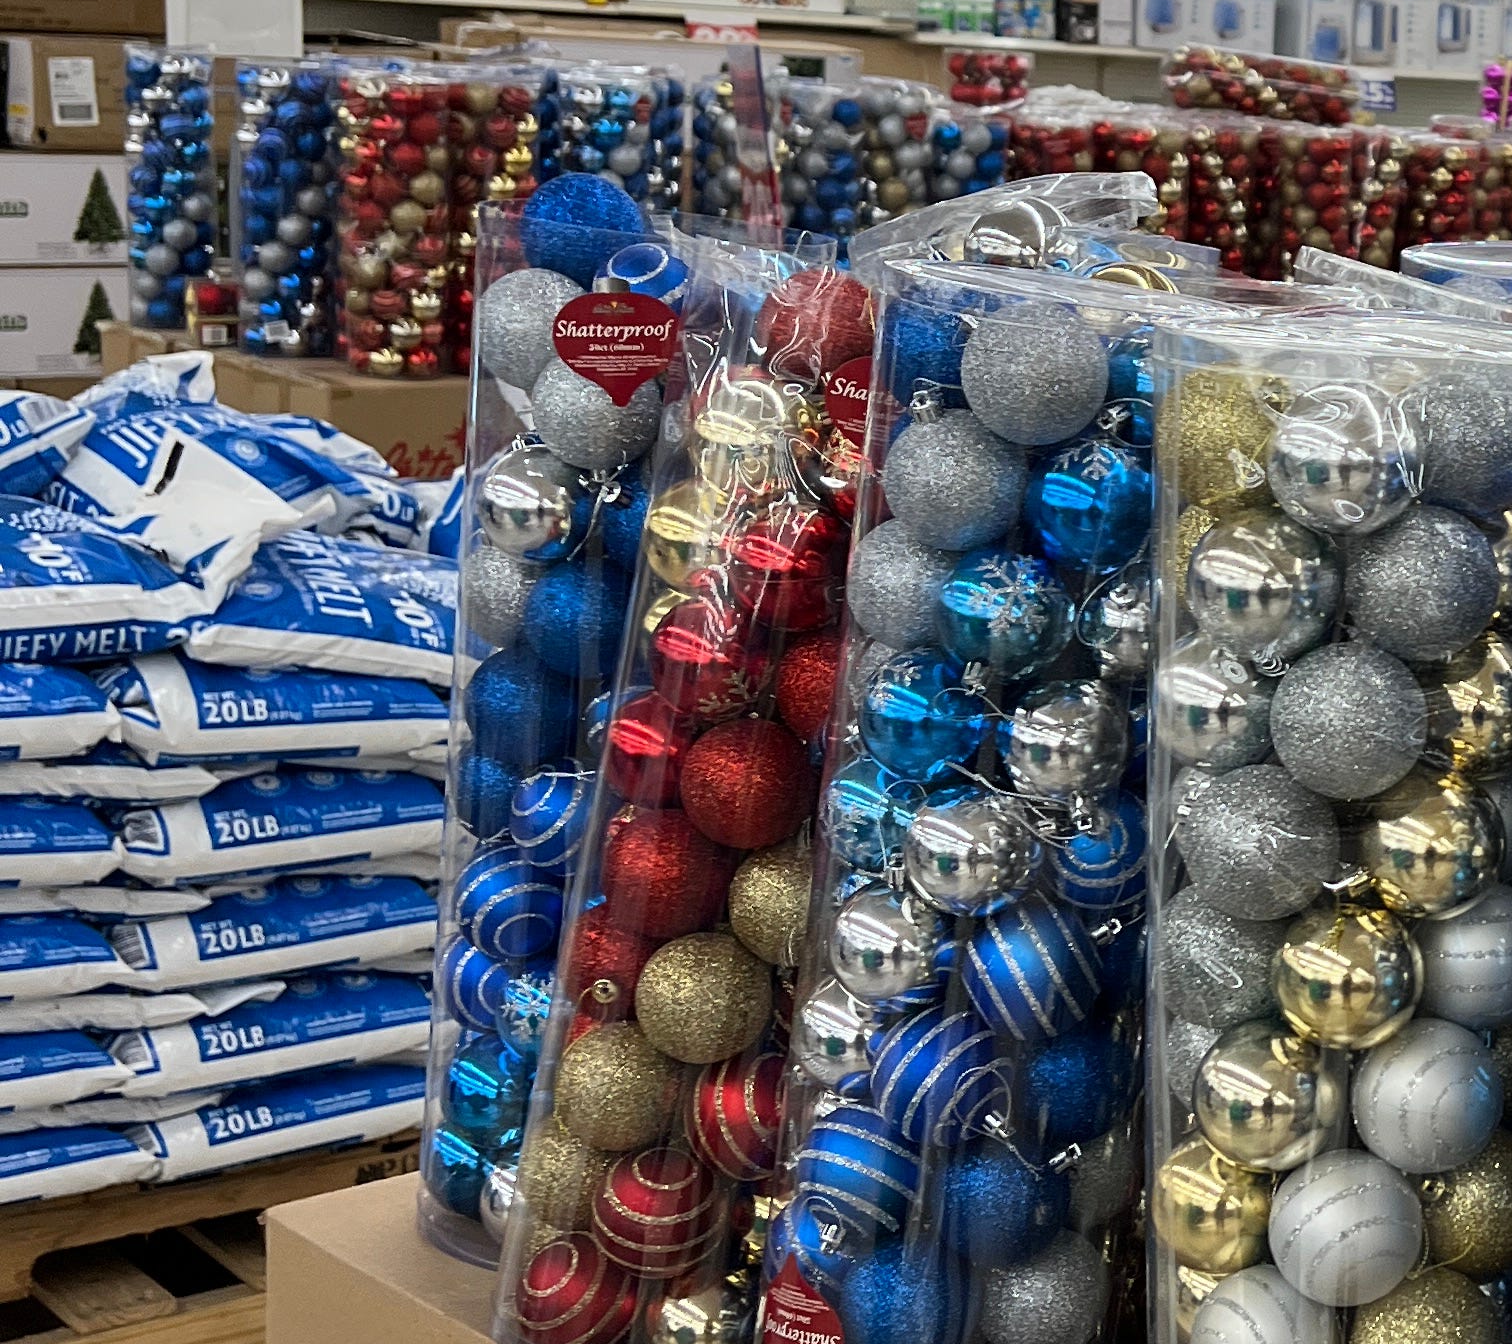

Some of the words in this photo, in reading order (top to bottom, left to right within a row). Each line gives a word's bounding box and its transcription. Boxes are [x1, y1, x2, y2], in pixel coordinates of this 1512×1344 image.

[555, 318, 675, 343] Shatterproof
[0, 630, 67, 661] IFFY
[72, 624, 148, 655] MELT
